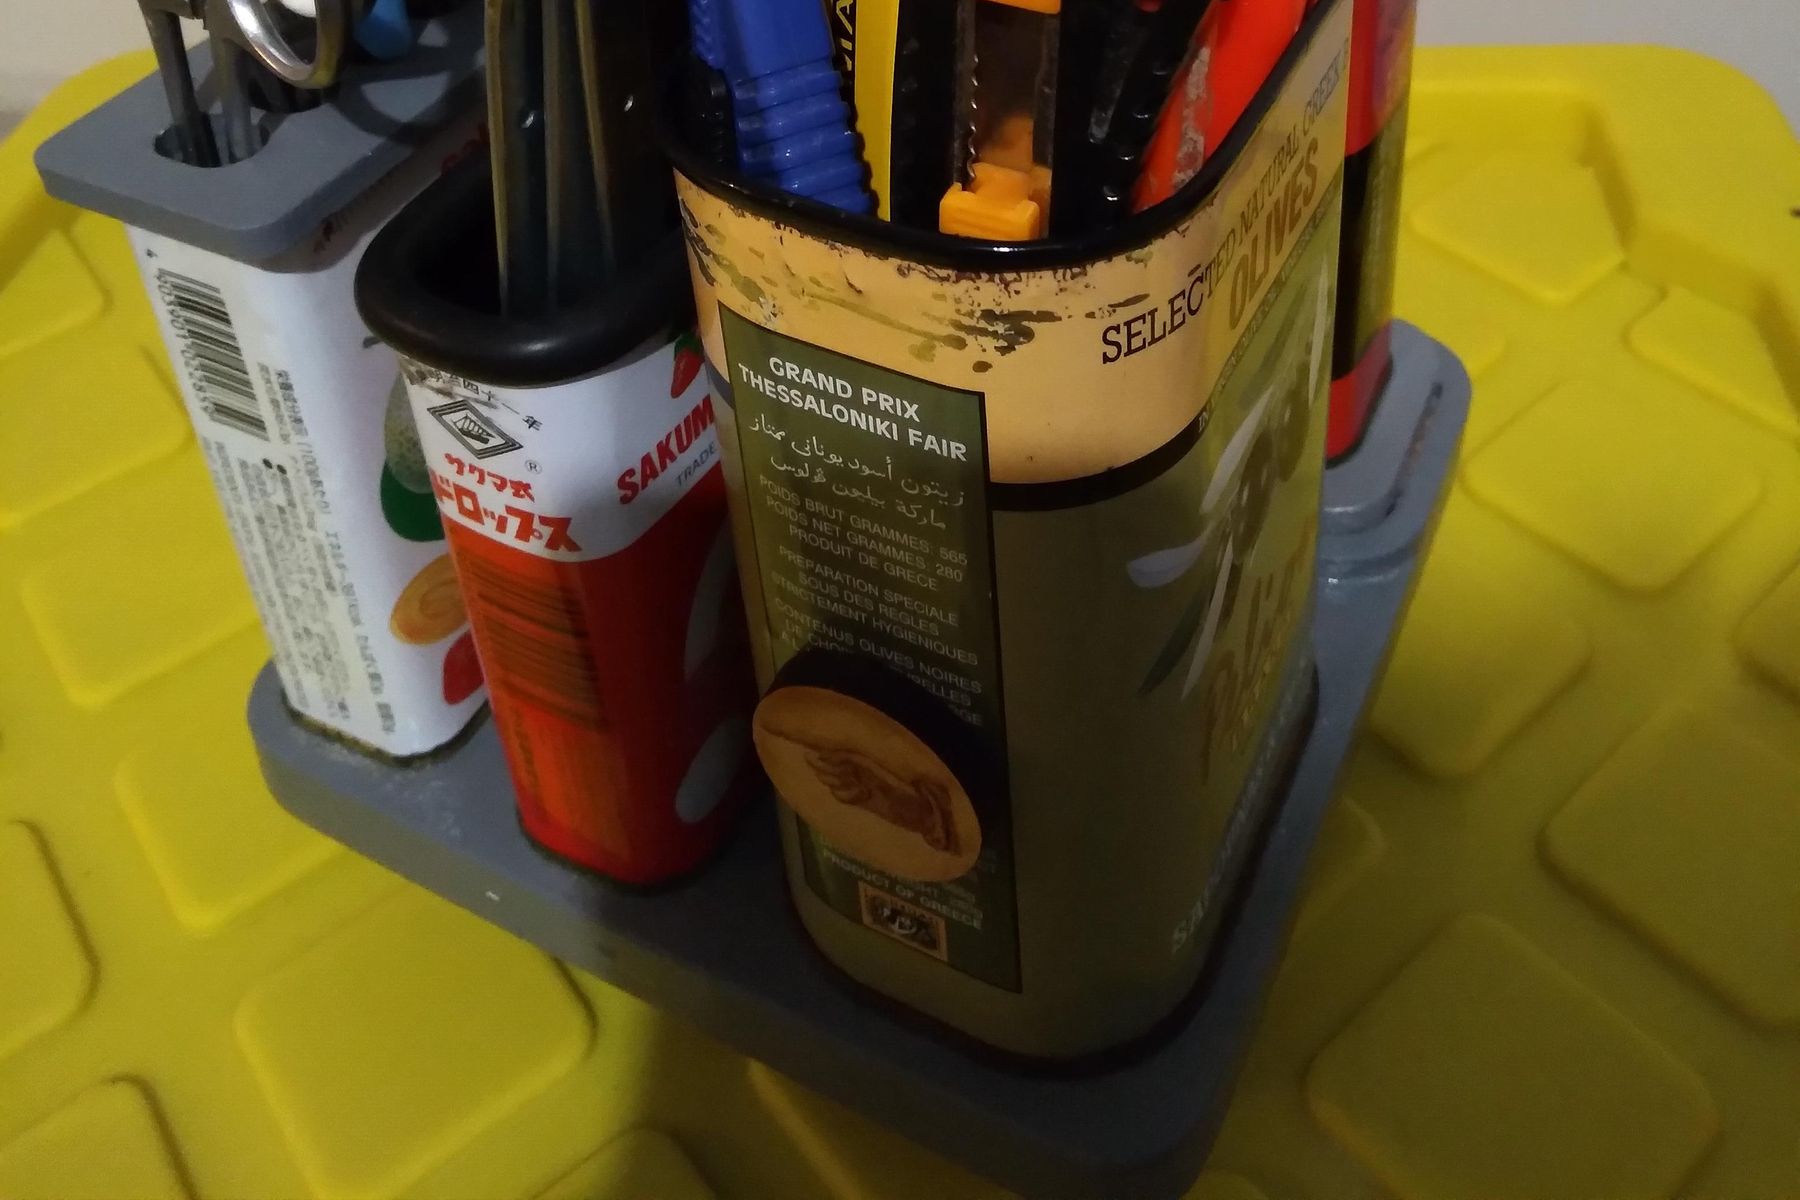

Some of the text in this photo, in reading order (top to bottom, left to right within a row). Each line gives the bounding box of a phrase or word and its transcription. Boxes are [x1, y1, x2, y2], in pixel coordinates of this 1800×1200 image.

[1102, 232, 1235, 364] SELECTED
[1233, 129, 1299, 246] NATURAL
[1229, 135, 1319, 330] OLIVES
[738, 362, 968, 462] THESSALONIKI FAIR
[769, 356, 920, 422] GRAND PRIX
[444, 453, 537, 502] サクマ式
[675, 441, 716, 487] TRADE
[901, 477, 965, 507] زيتون
[430, 468, 582, 553] ドロップス
[759, 474, 801, 506] POIDS
[805, 498, 845, 522] BRUT
[938, 546, 968, 566] 565
[767, 496, 808, 527] POIDS
[811, 517, 841, 538] NET
[935, 563, 963, 583] 280
[779, 545, 960, 627] PREPARATION SPECIALE
[789, 524, 938, 591] PRODUIT DE GRECE
[771, 571, 979, 666] STRICTEMENT HYGIENIQUES
[775, 597, 856, 646] CONTENUS
[859, 638, 914, 671] OLIVES
[919, 662, 983, 696] NOIRES
[799, 571, 940, 637] SOUS DES REGLES
